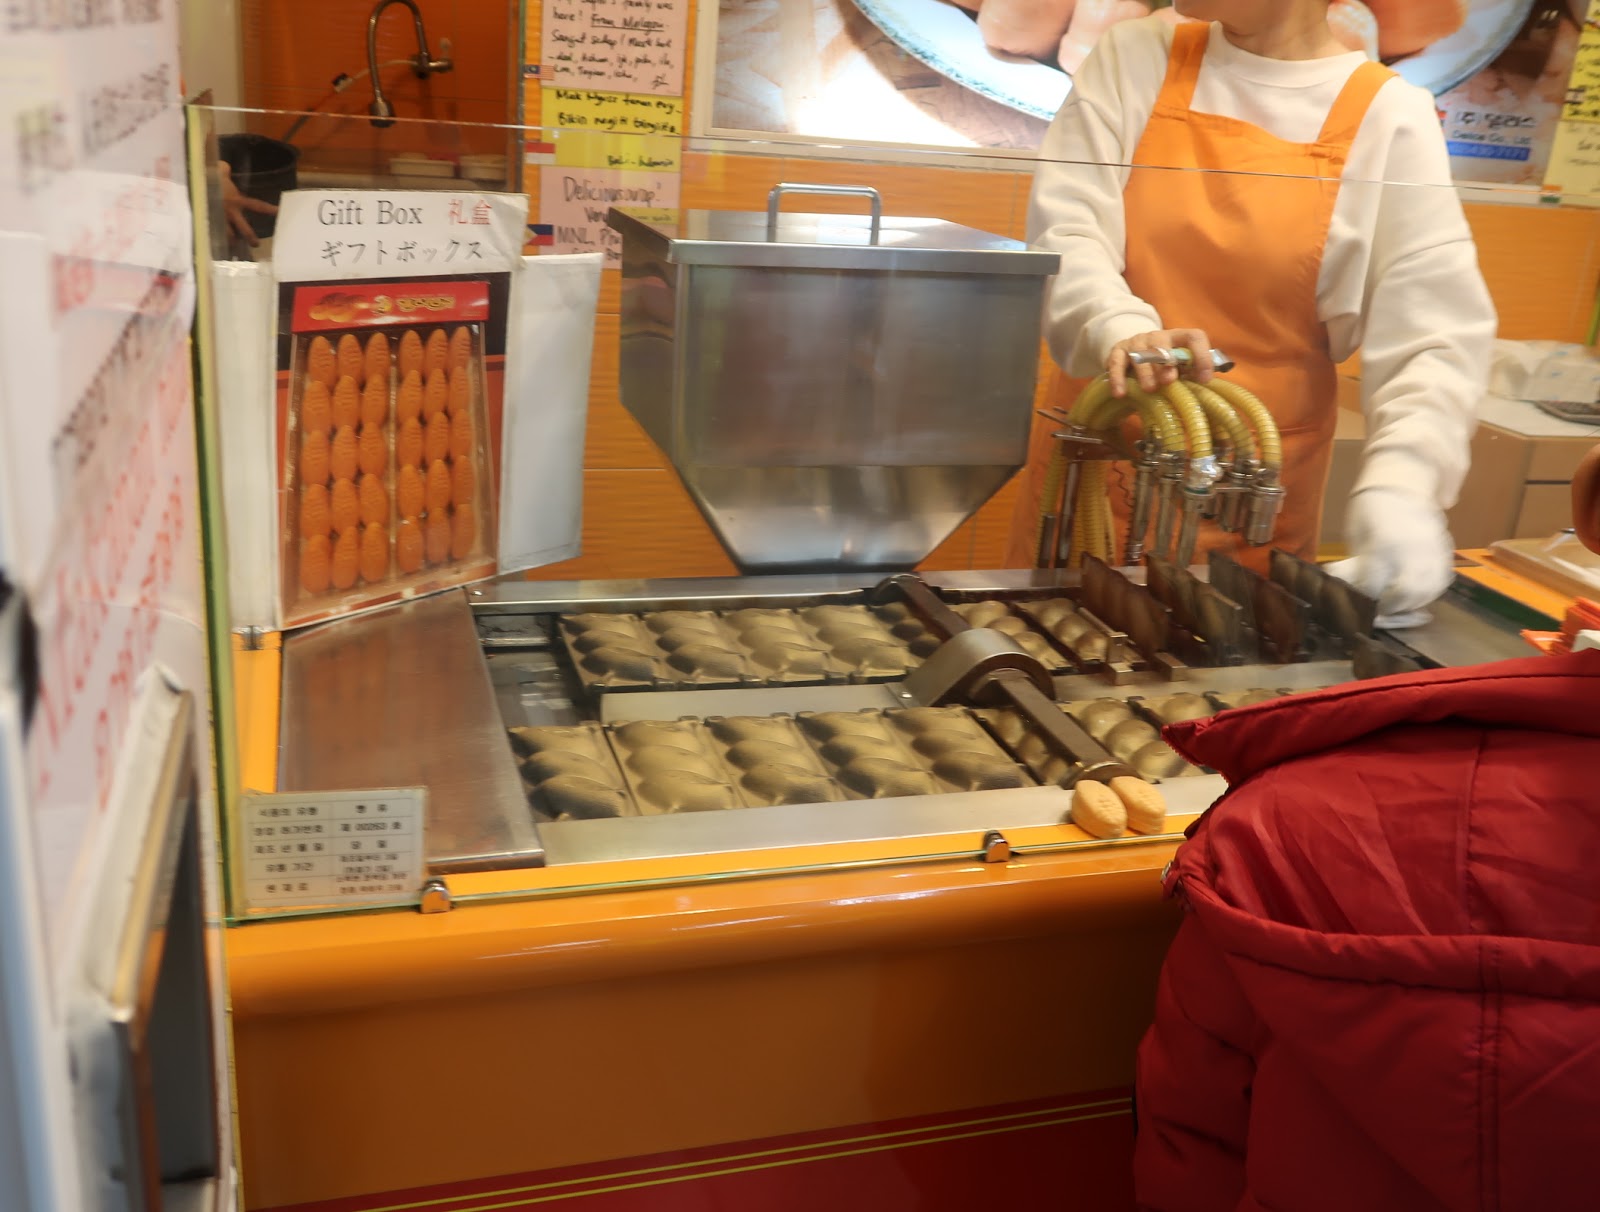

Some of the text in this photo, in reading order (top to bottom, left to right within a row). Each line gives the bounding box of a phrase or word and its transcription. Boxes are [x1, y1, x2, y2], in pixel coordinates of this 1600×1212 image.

[317, 199, 423, 226] Gift Box
[447, 198, 493, 226] 礼盒
[321, 239, 484, 268] ギフトボックス
